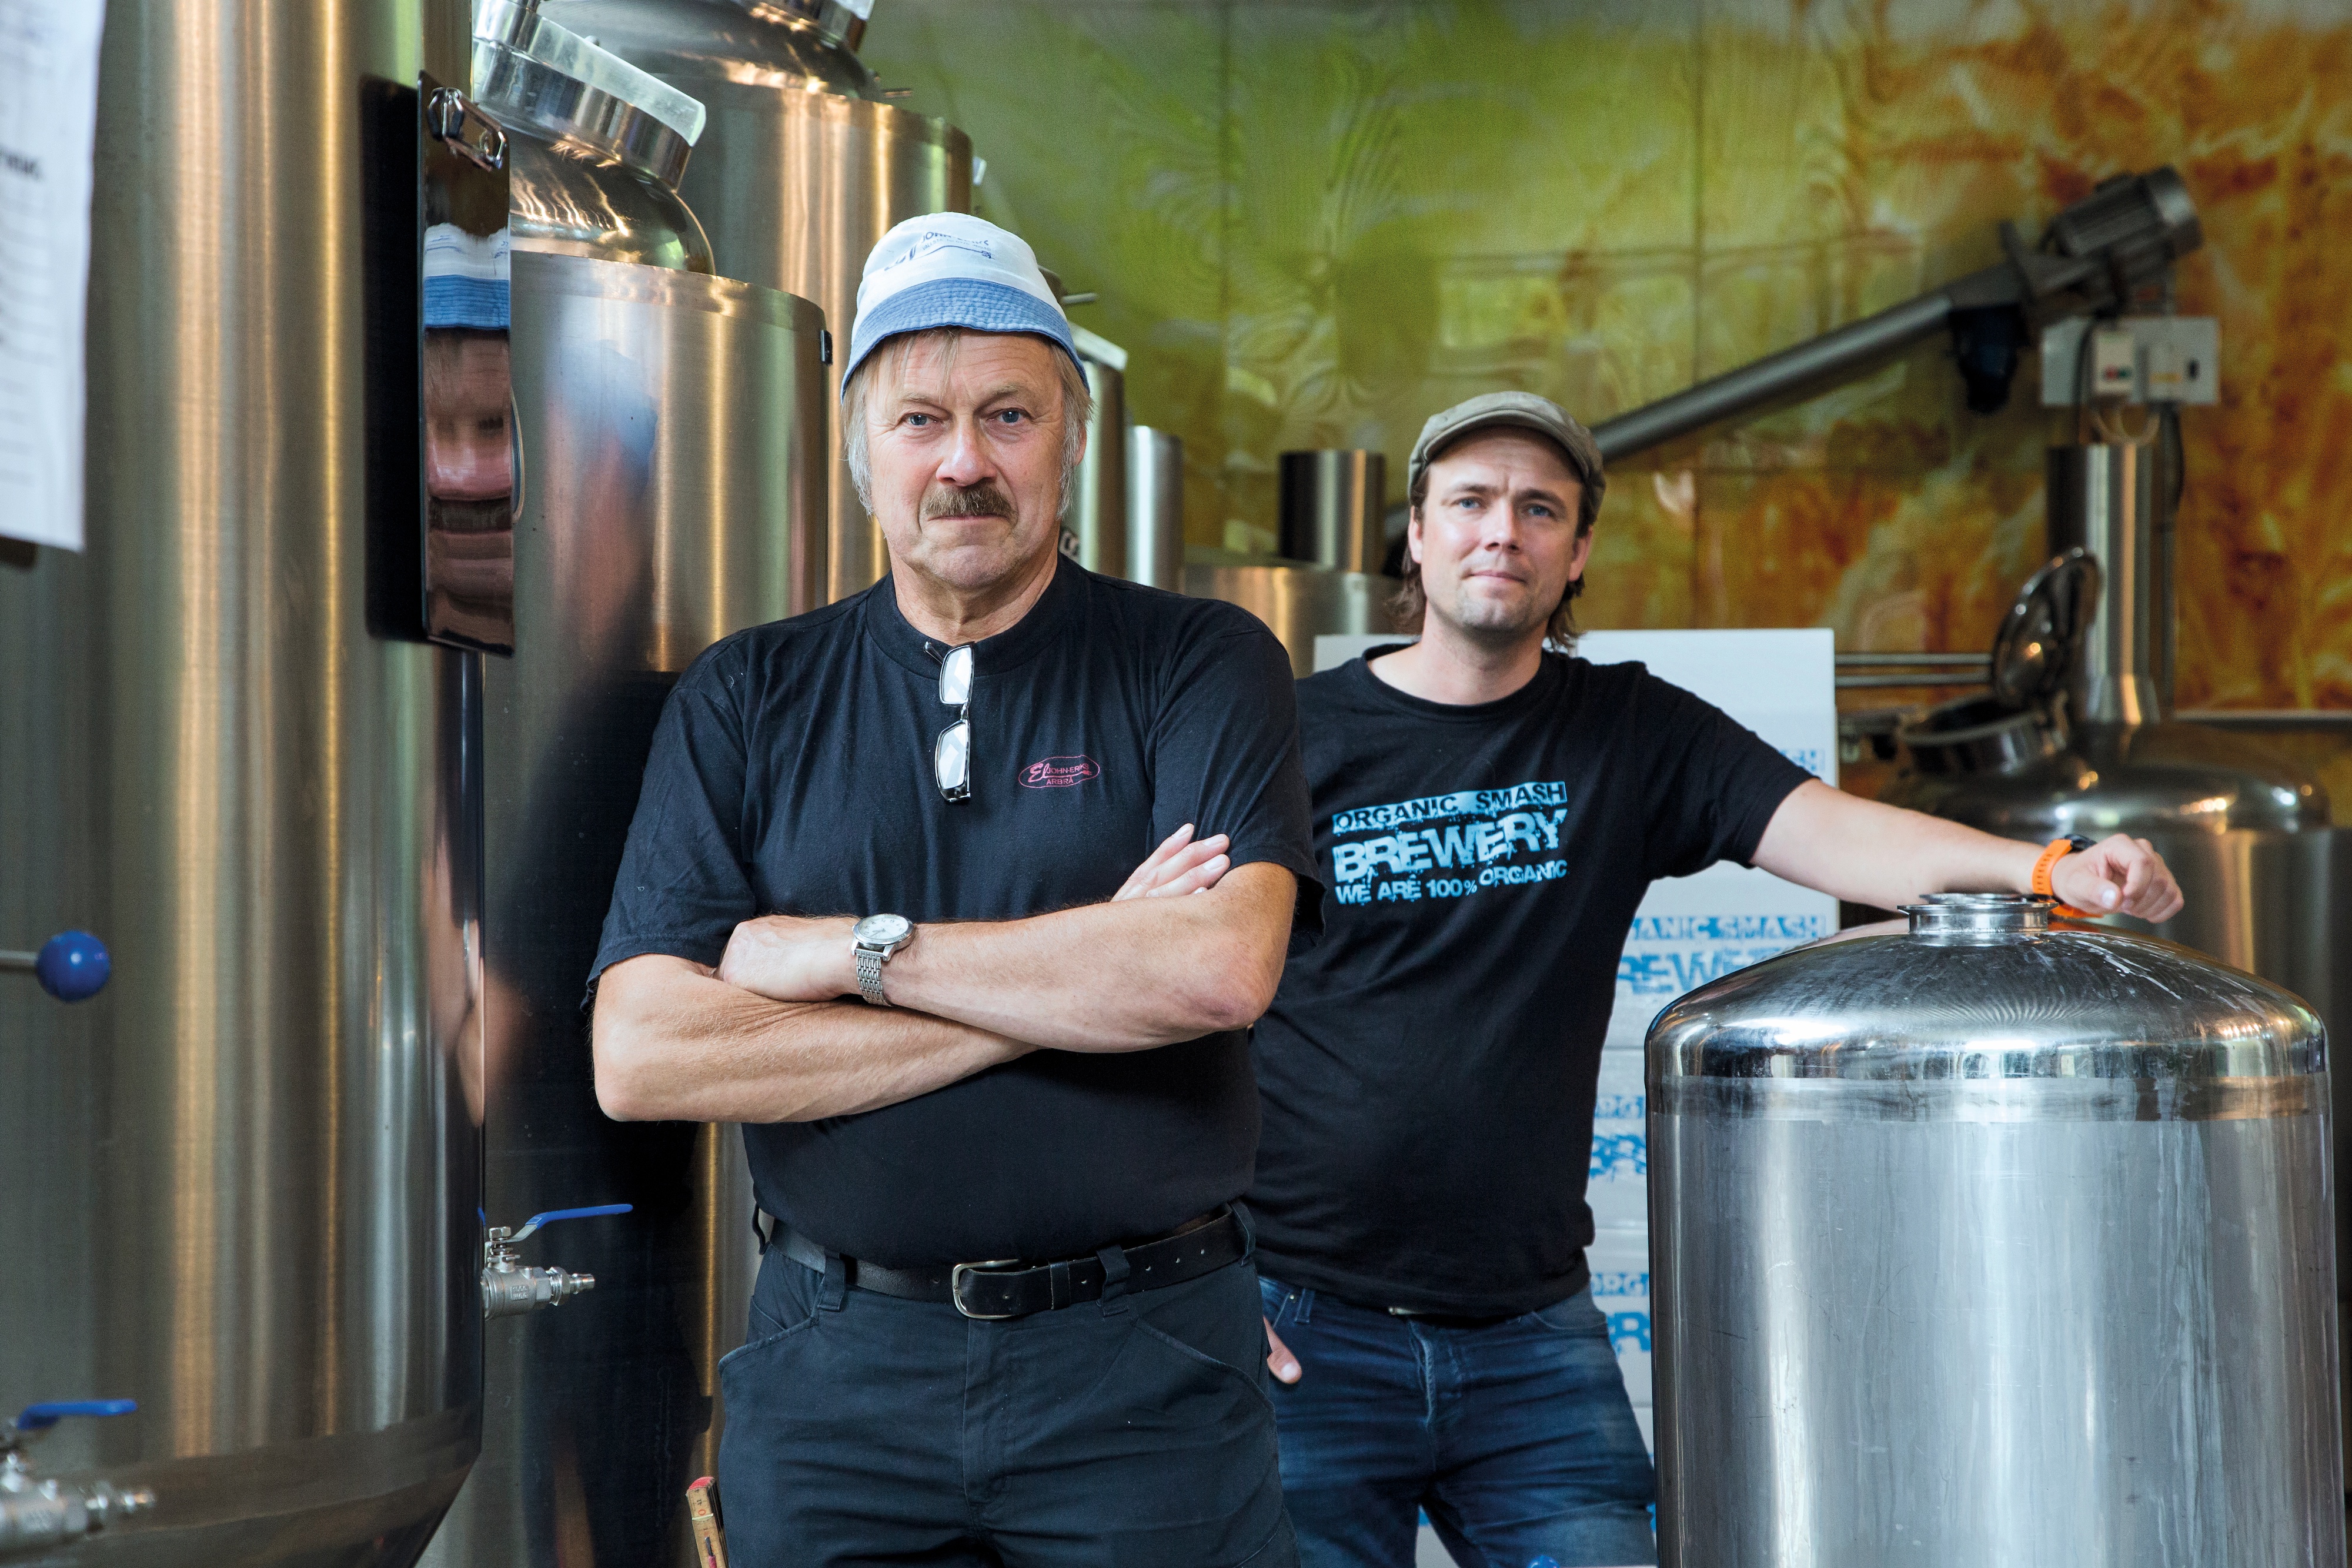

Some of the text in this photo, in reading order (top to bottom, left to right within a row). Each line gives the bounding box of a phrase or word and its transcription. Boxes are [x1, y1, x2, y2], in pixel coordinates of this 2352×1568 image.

[1335, 783, 1567, 828] ORGANIC SMASH
[1332, 808, 1568, 883] BREWERY
[1335, 860, 1568, 905] WE ARE 100% ORGANIC
[1630, 916, 1711, 940] ANIC
